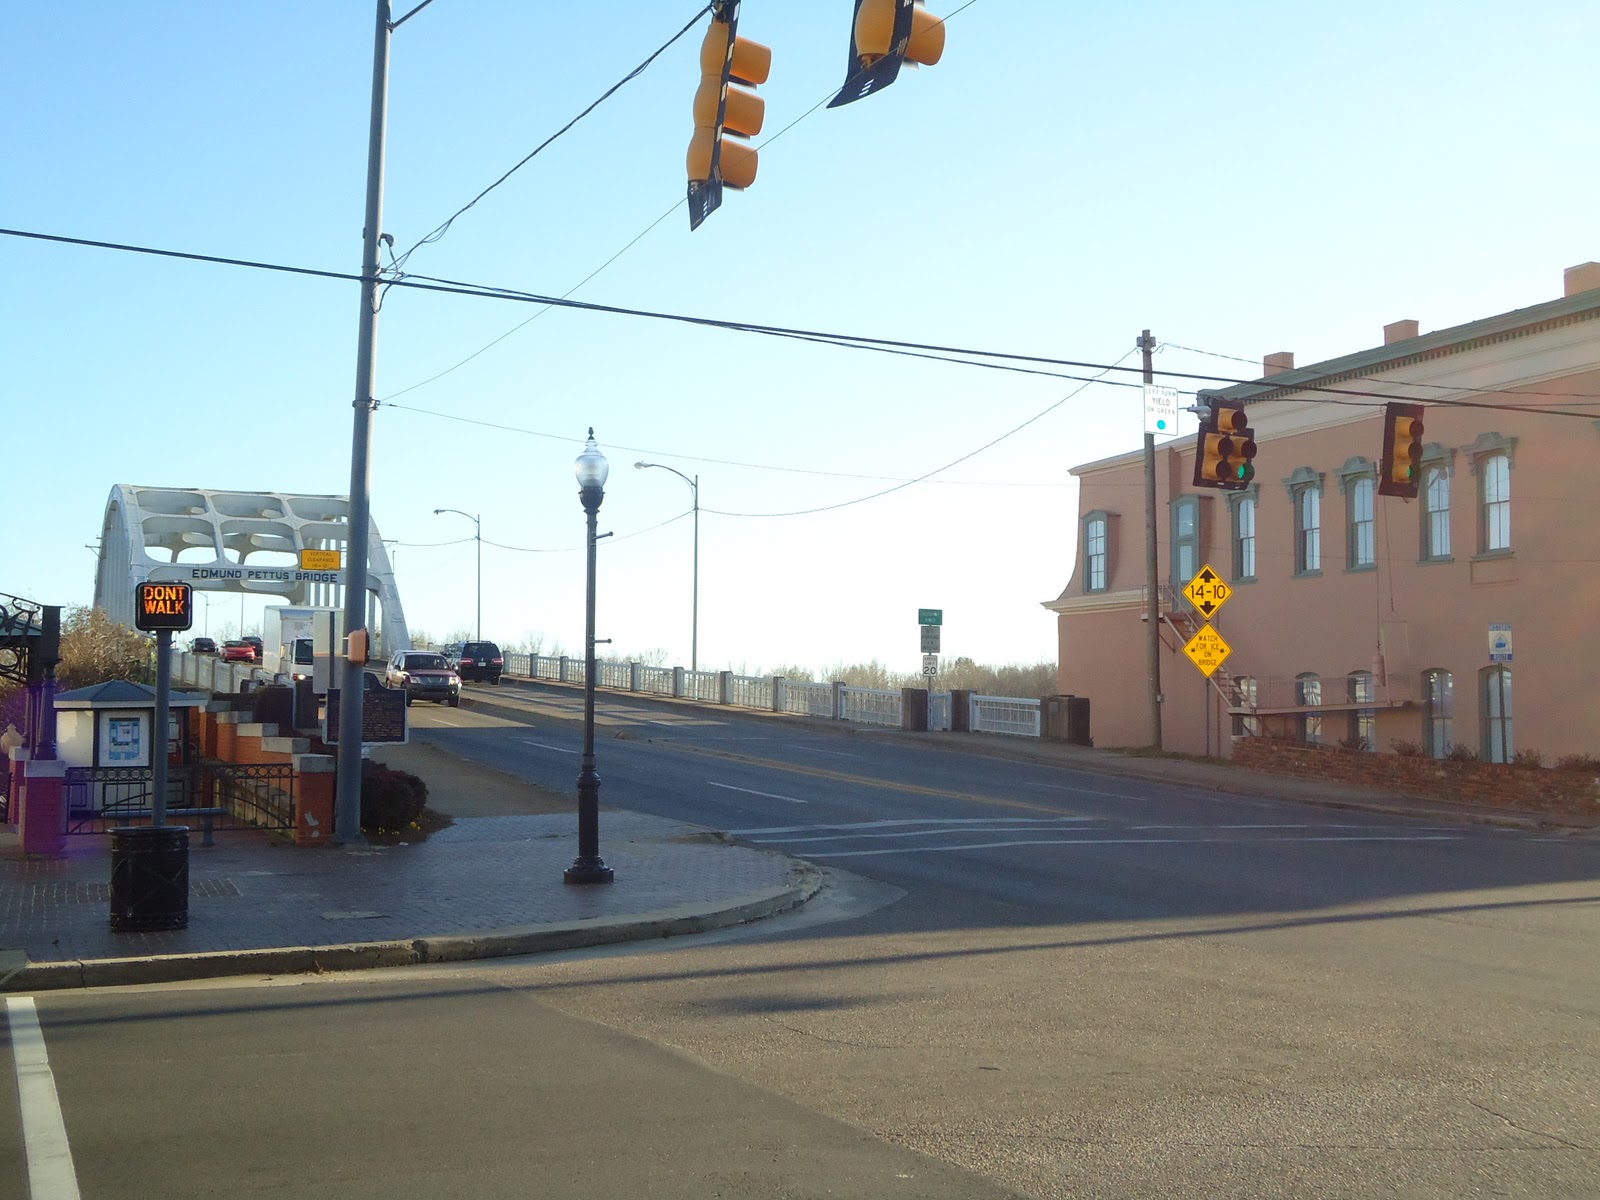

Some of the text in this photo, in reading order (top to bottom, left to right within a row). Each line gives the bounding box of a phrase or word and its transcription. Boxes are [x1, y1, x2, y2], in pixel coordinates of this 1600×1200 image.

[1152, 398, 1170, 406] YIELD
[192, 568, 338, 583] EDMUND PETTUS BRIDGE
[143, 586, 185, 600] DONT
[144, 600, 185, 615] WALK
